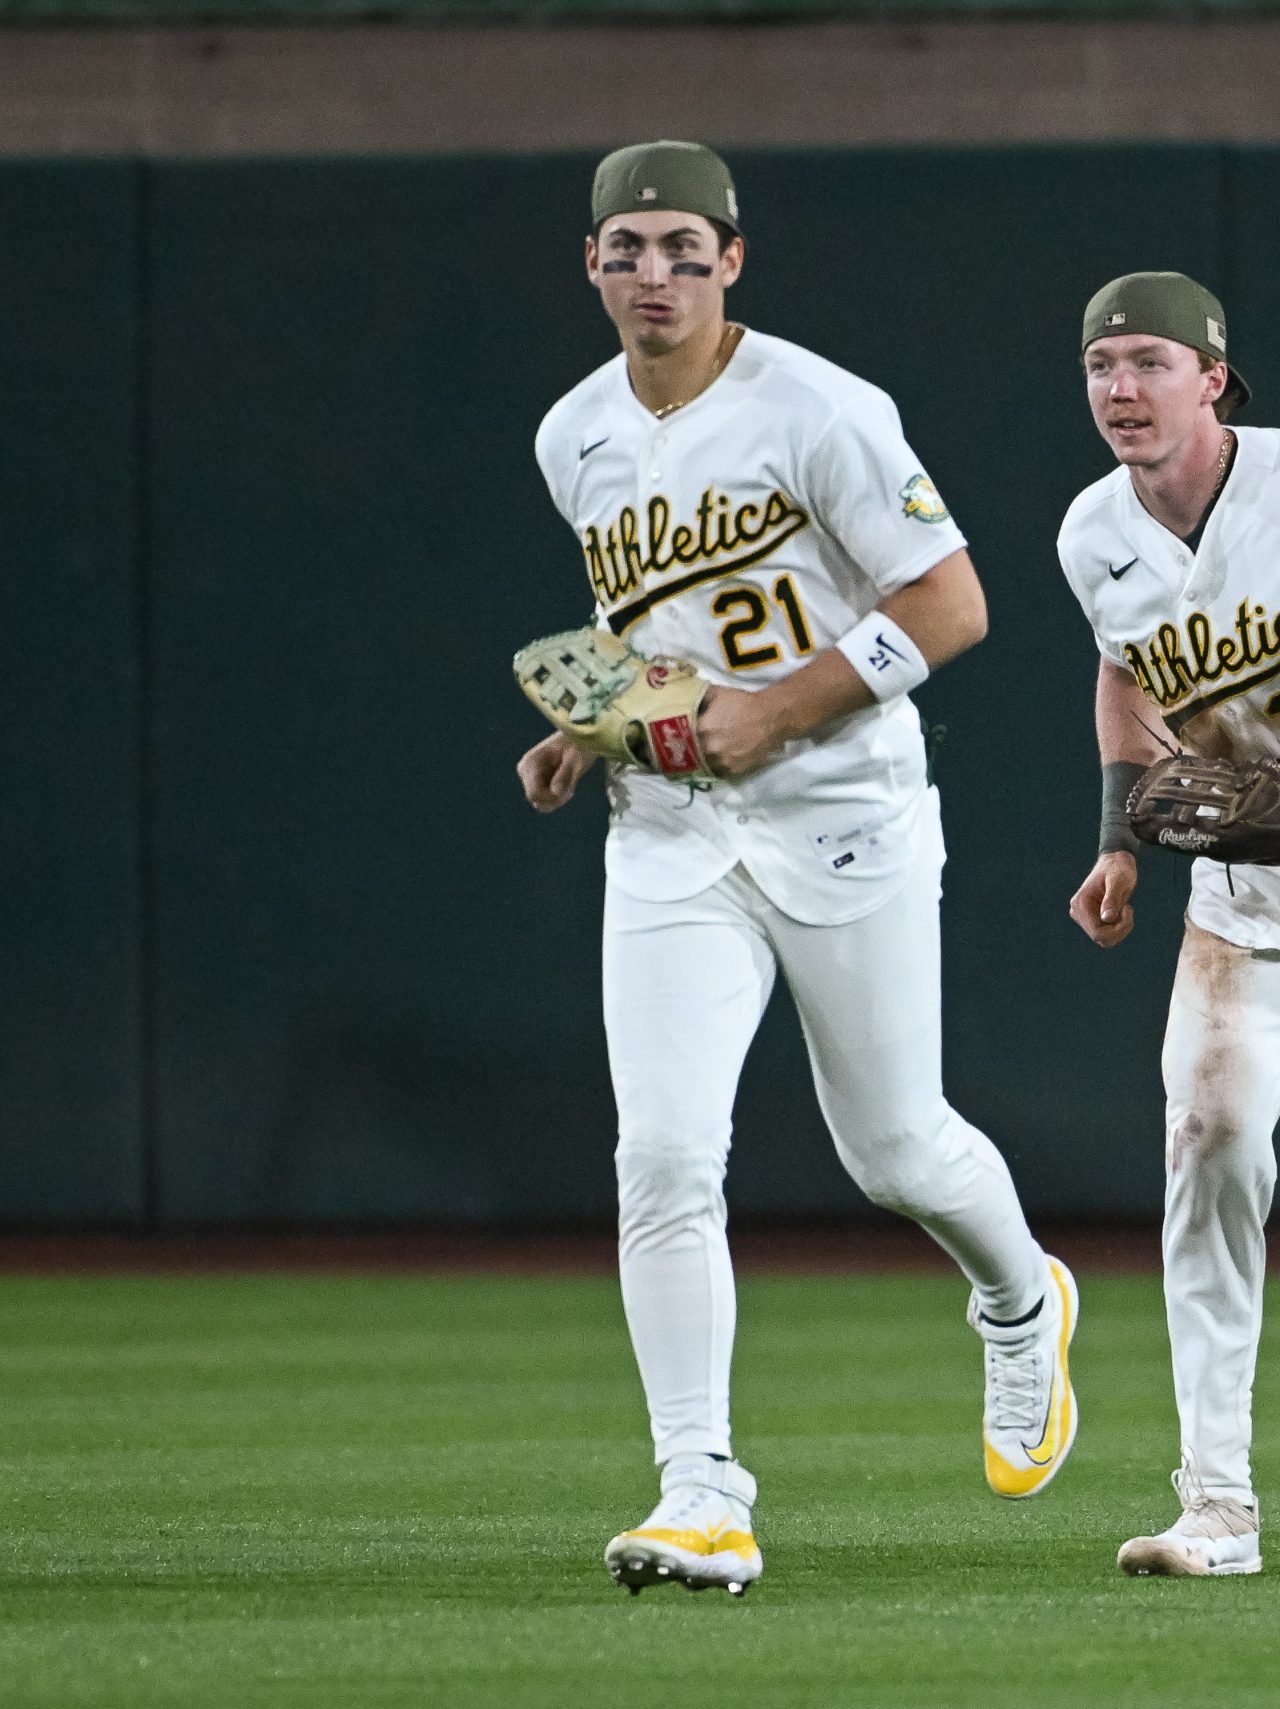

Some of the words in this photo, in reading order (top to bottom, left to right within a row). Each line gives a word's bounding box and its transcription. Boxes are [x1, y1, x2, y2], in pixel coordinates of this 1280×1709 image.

[583, 484, 806, 606] Athletics
[710, 570, 814, 669] 21
[868, 650, 891, 671] 21
